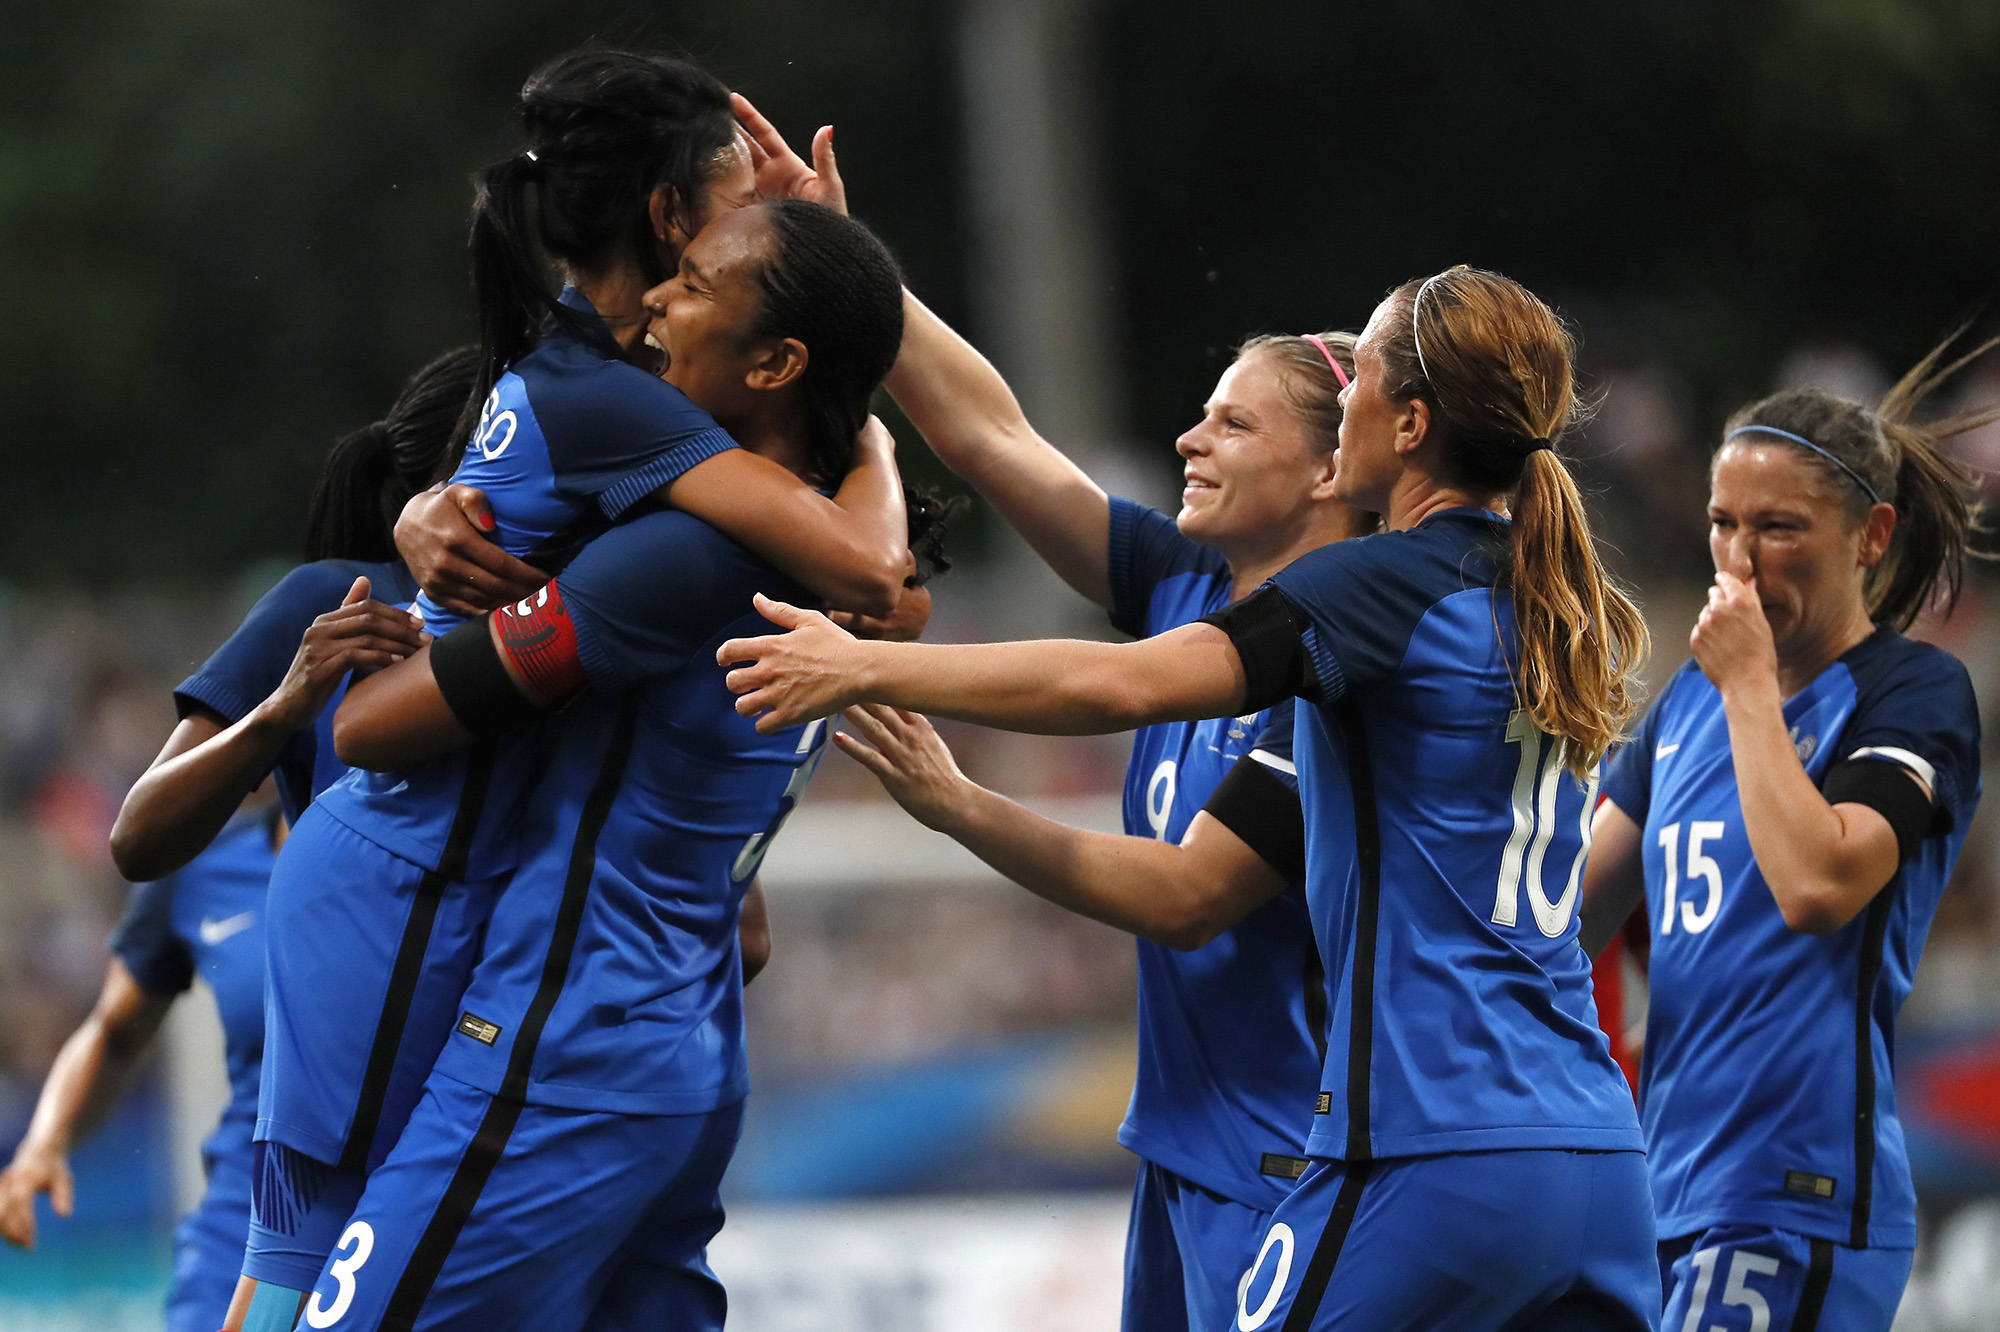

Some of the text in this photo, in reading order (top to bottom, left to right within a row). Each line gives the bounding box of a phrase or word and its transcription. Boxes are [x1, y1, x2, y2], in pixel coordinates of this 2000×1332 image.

[1146, 760, 1177, 842] 9
[1491, 708, 1601, 938] 10
[1658, 820, 1725, 935] 15
[306, 1221, 375, 1329] 3
[1681, 1246, 1780, 1332] 15
